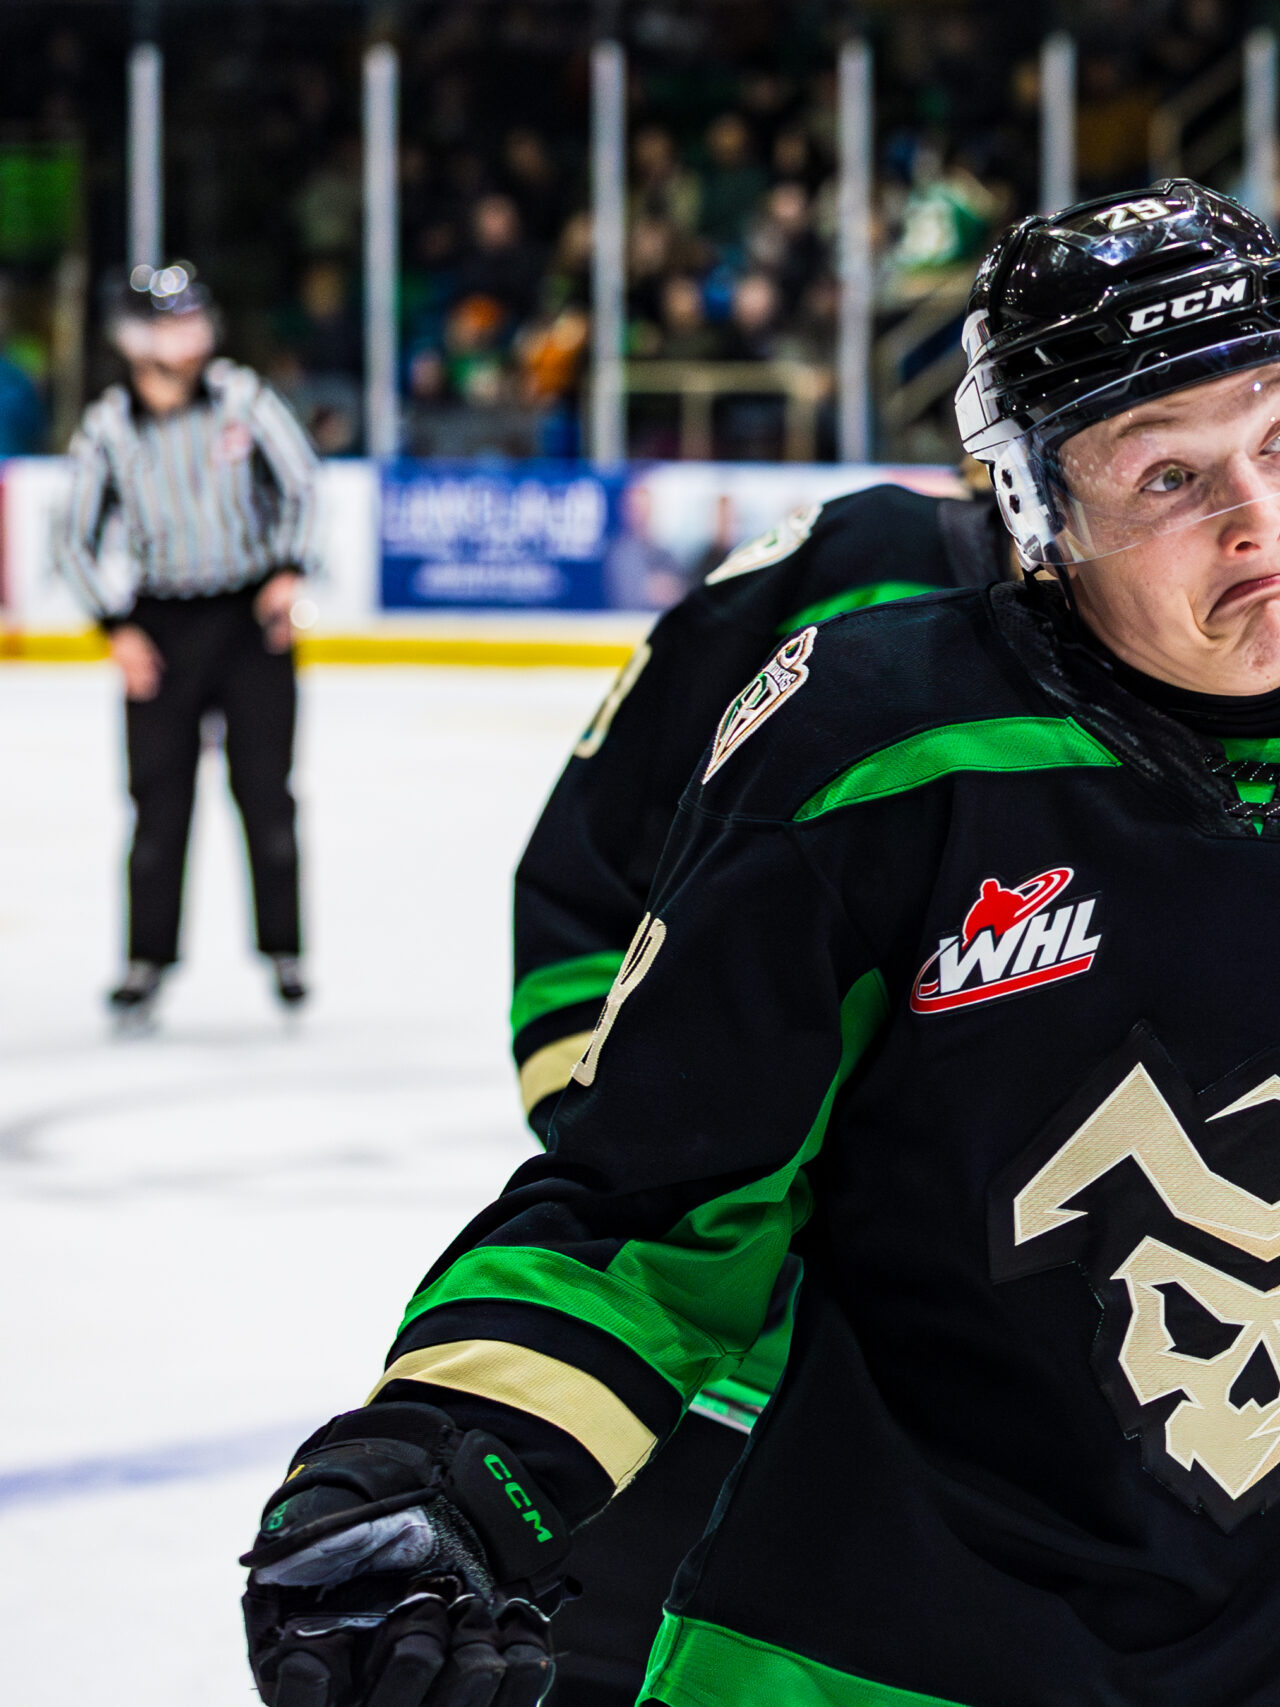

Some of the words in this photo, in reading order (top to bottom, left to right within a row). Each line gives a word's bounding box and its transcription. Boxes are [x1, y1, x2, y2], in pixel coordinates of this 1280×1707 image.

[1093, 198, 1172, 232] 29
[1128, 279, 1251, 334] CCM
[938, 898, 1102, 994] WHL
[483, 1453, 554, 1544] CCM
